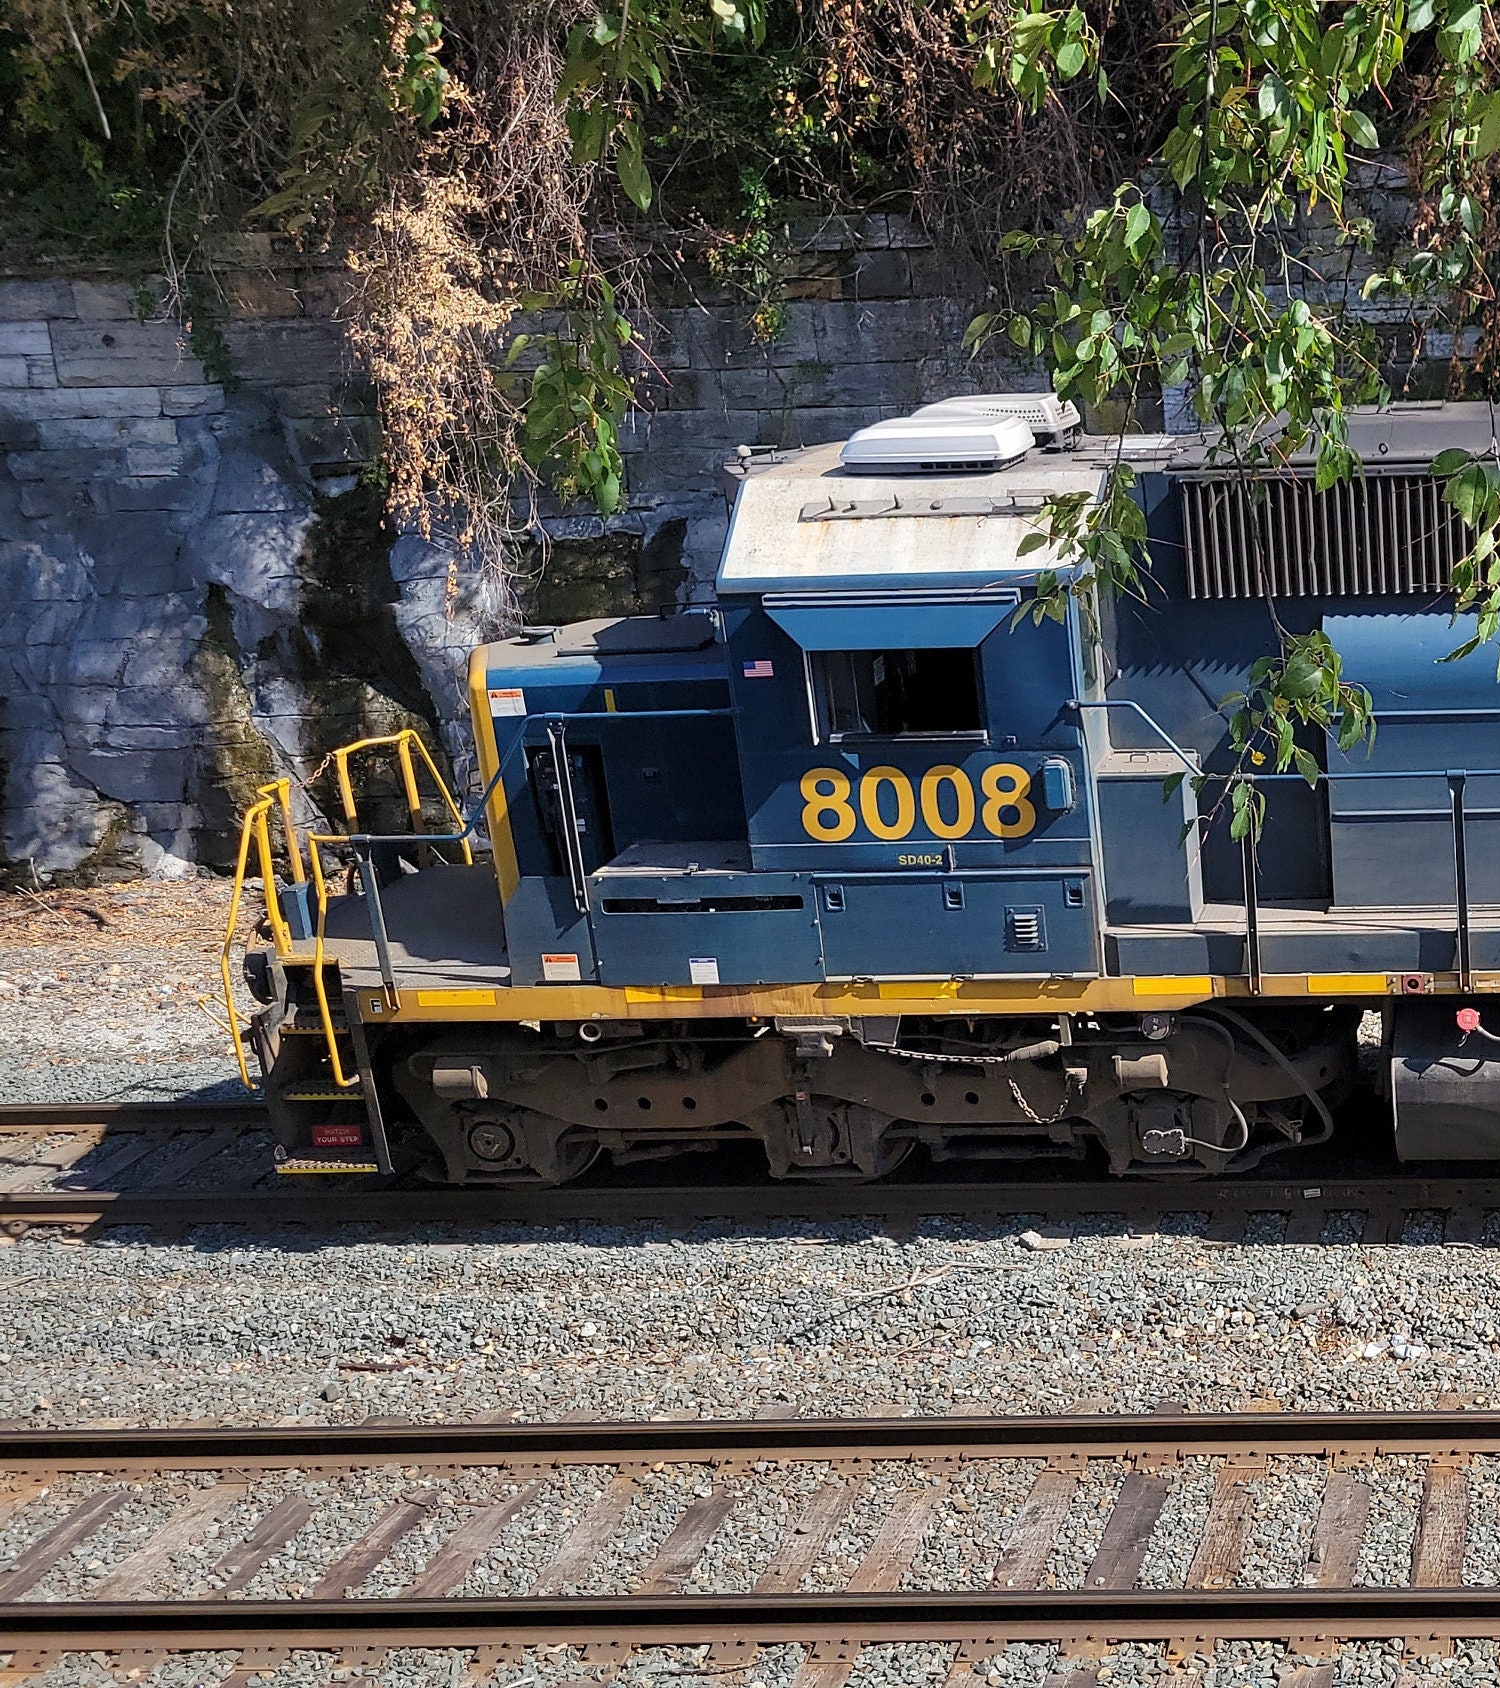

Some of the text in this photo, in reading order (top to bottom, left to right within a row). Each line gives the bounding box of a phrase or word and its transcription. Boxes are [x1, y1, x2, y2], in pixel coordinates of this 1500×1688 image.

[800, 763, 1037, 843] 8008
[898, 854, 943, 866] SD40-2
[370, 999, 381, 1013] F
[324, 1127, 350, 1135] WATCH
[340, 1135, 358, 1143] STEP
